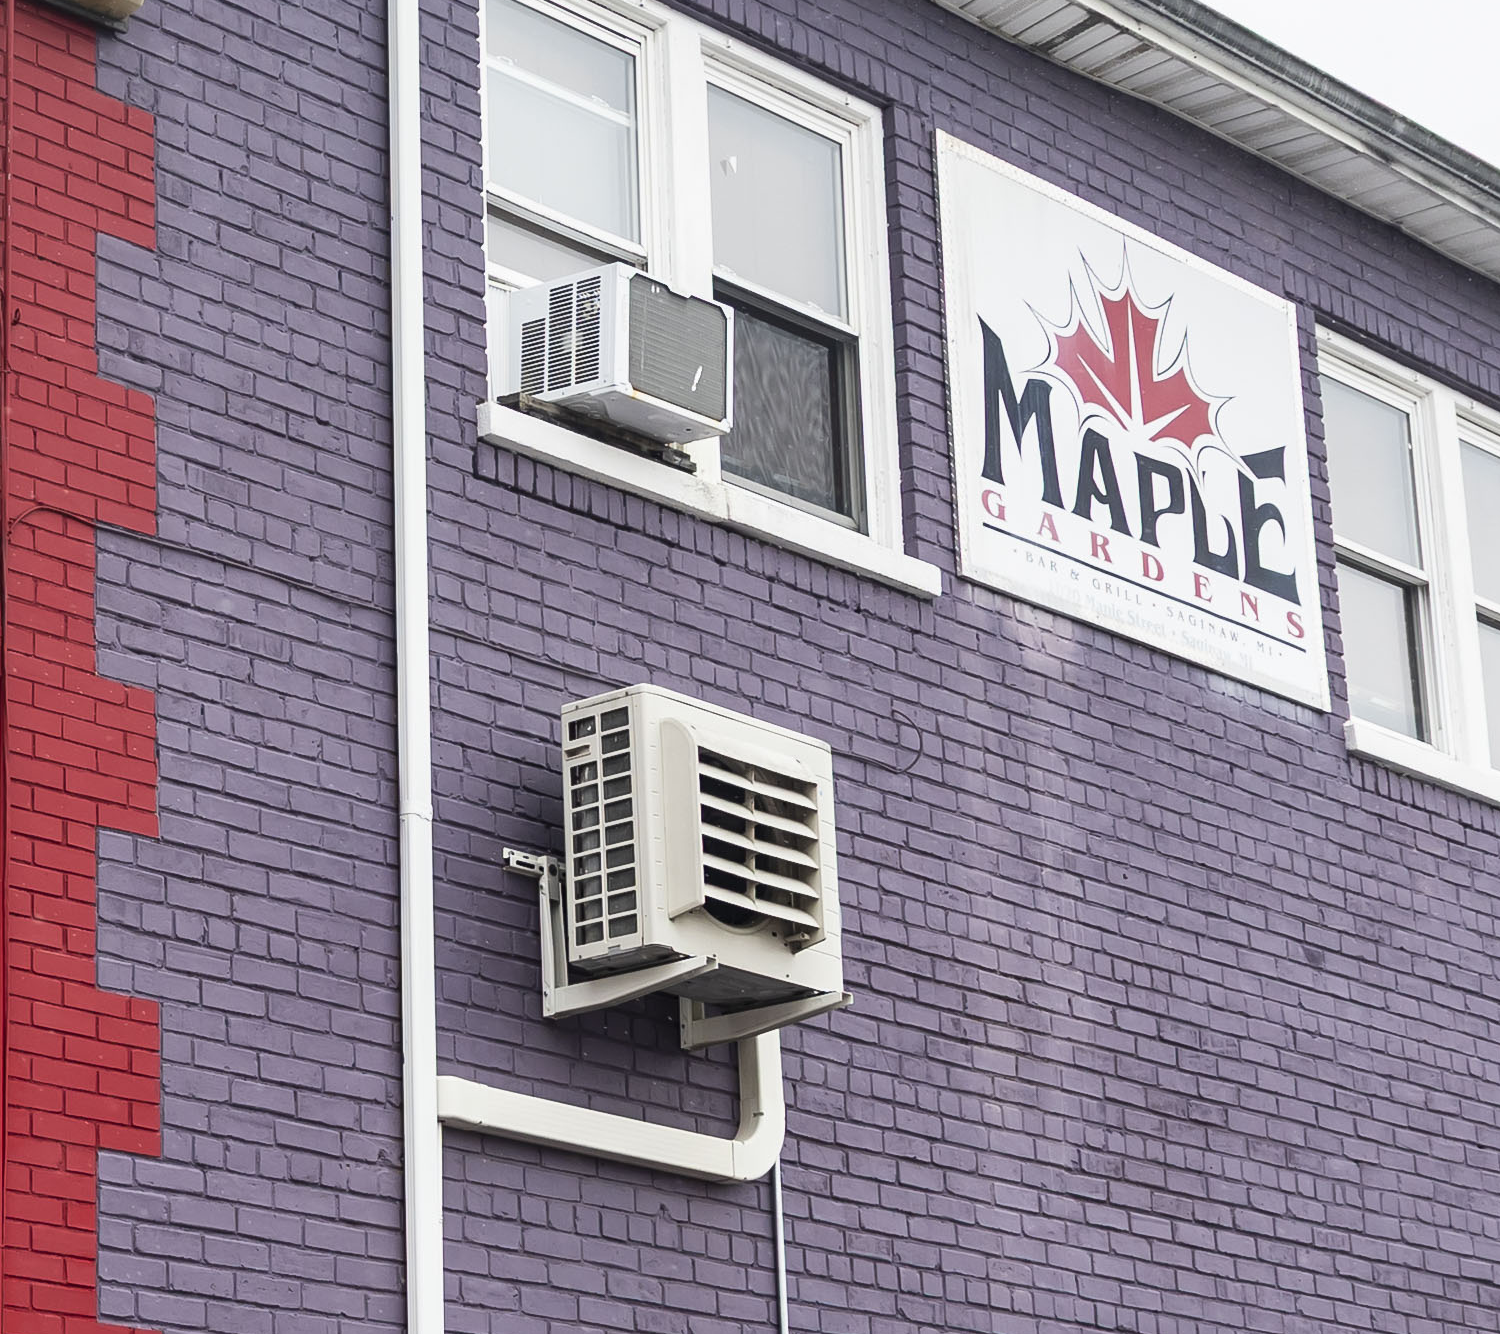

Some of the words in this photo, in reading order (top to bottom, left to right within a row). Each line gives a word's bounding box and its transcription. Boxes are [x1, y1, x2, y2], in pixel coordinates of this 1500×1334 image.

[976, 312, 1302, 606] MAPLE
[981, 489, 1305, 639] GARDENS
[1025, 550, 1058, 573] BAR
[1070, 568, 1080, 581] &
[1092, 578, 1143, 605] GRILL
[1256, 640, 1273, 657] MI
